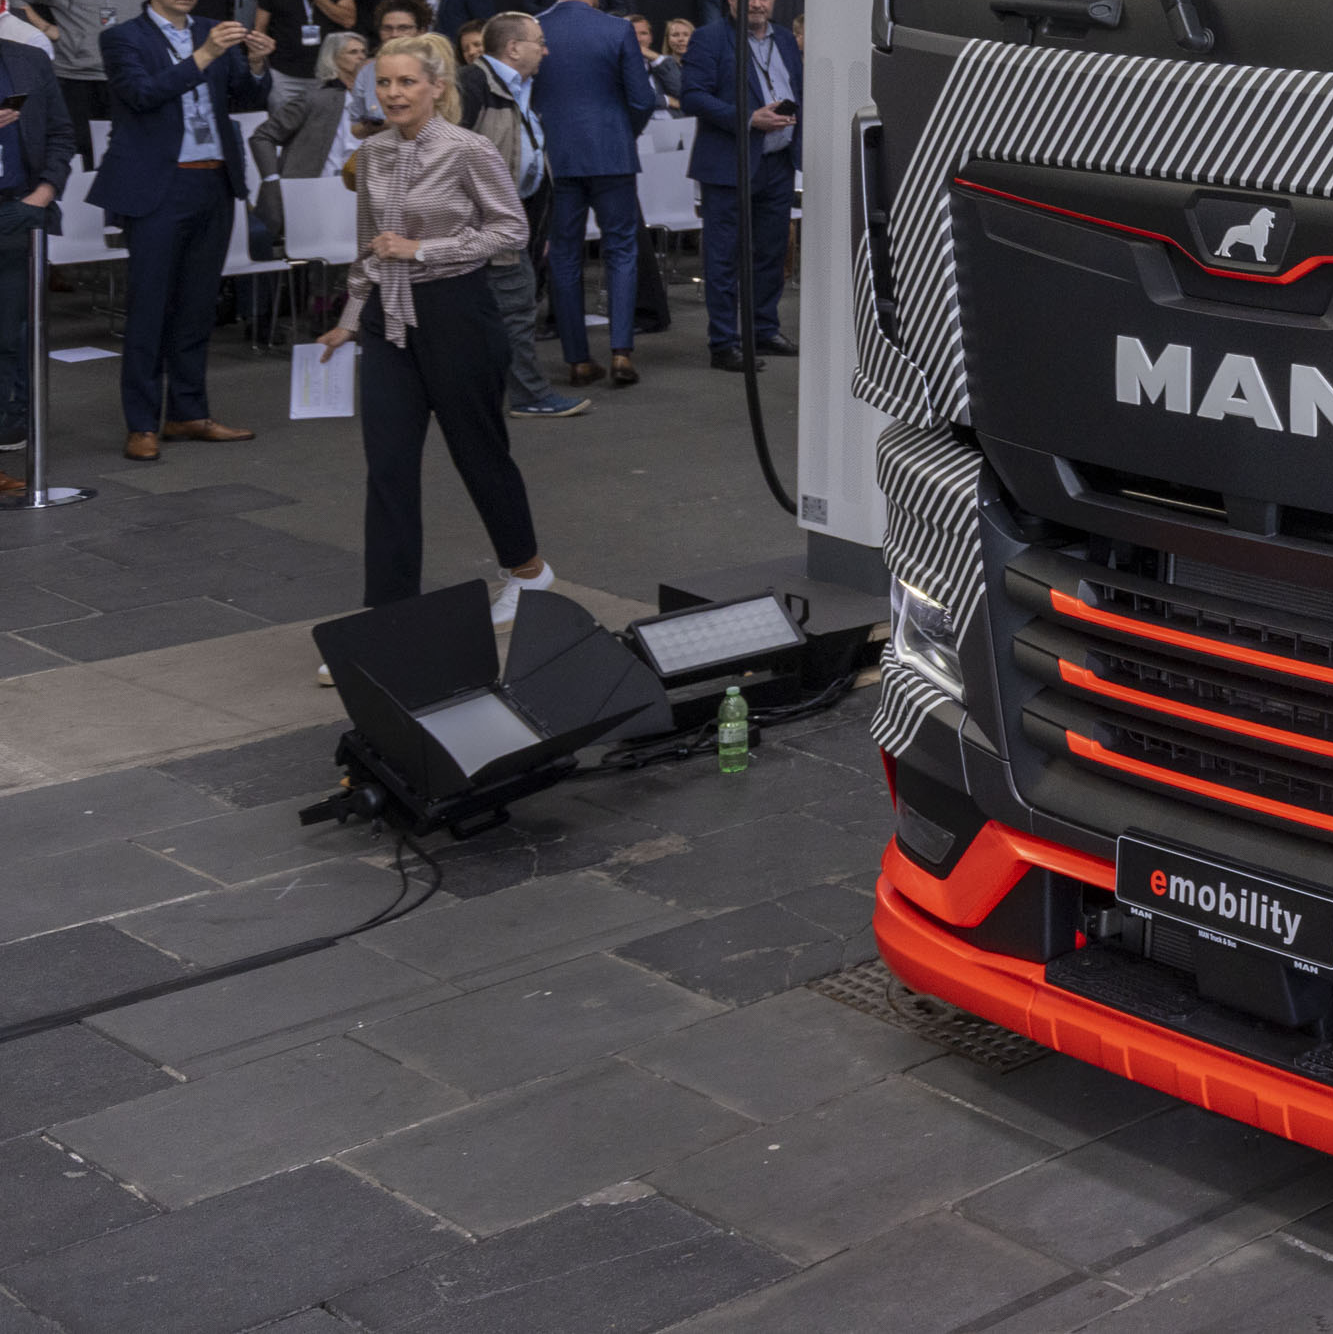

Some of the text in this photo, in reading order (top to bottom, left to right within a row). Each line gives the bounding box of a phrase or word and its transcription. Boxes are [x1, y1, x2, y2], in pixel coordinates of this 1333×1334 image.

[1130, 906, 1153, 920] MAN
[1150, 869, 1302, 945] emobility
[1294, 960, 1319, 975] MAN
